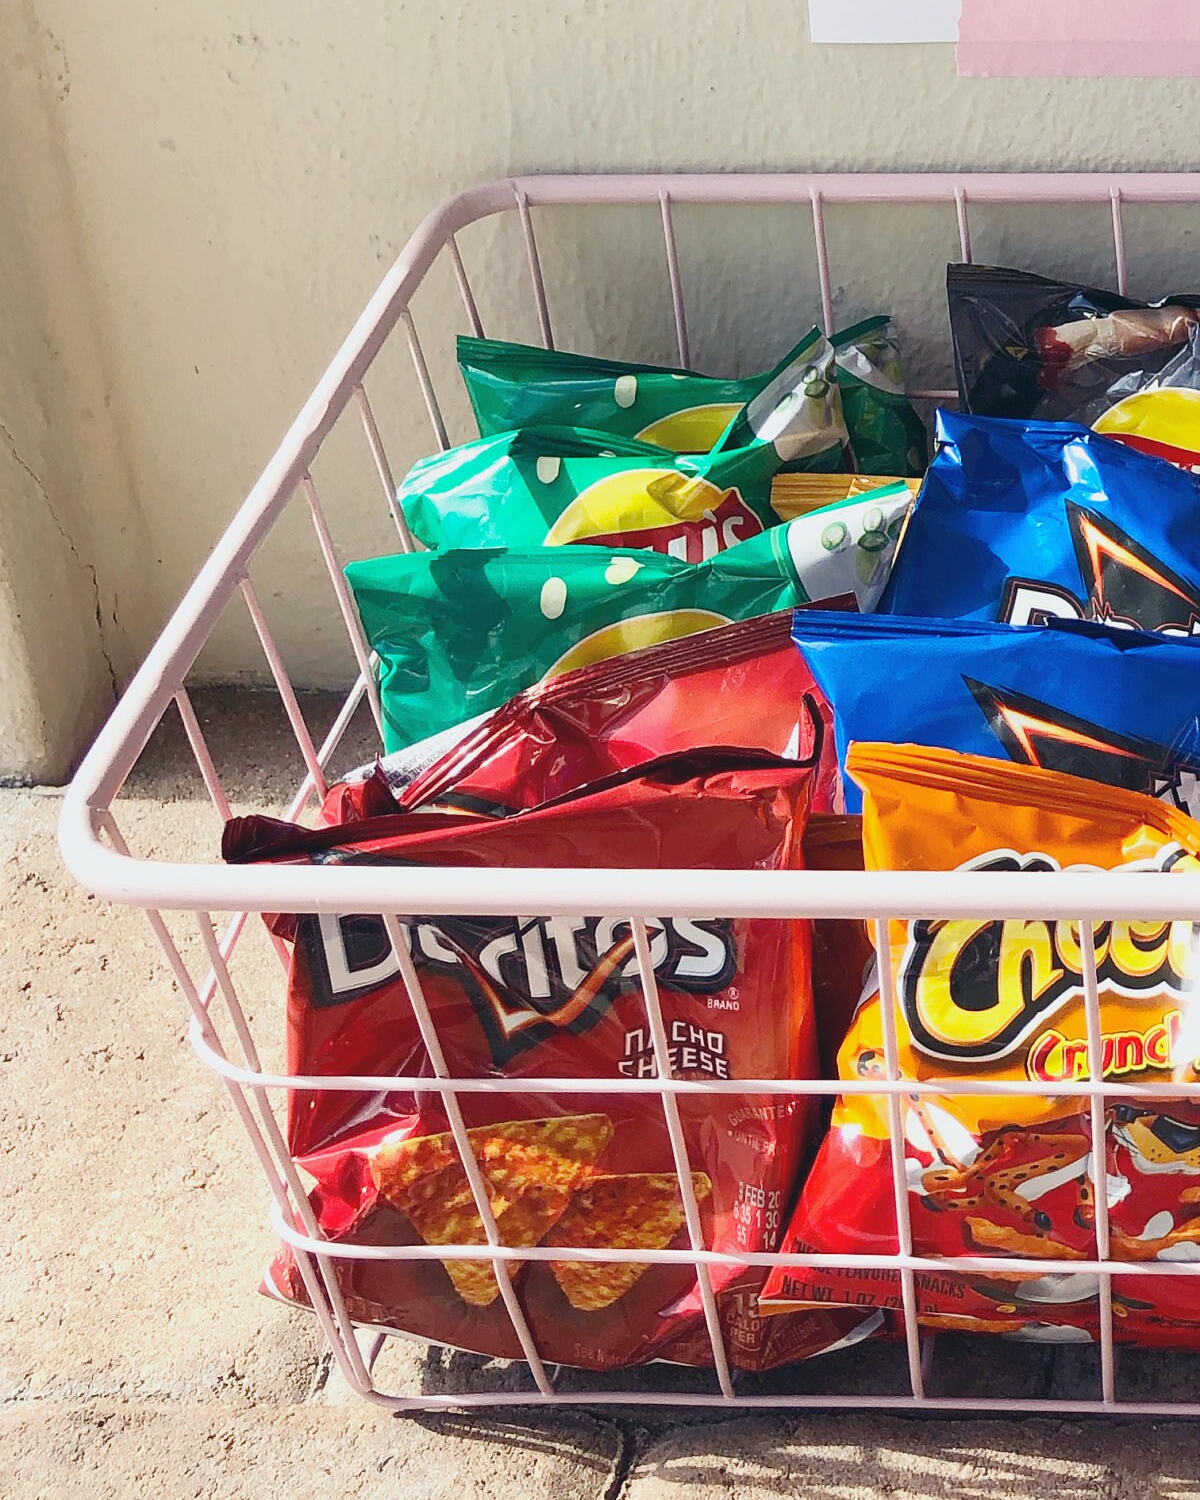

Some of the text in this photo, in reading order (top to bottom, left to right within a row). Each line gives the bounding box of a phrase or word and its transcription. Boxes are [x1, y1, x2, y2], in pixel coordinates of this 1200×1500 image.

[706, 998, 740, 1012] BRAND
[744, 1184, 766, 1209] FEB
[762, 1231, 777, 1250] 14
[838, 1266, 903, 1284] FLAVORE
[783, 1275, 807, 1297] NET
